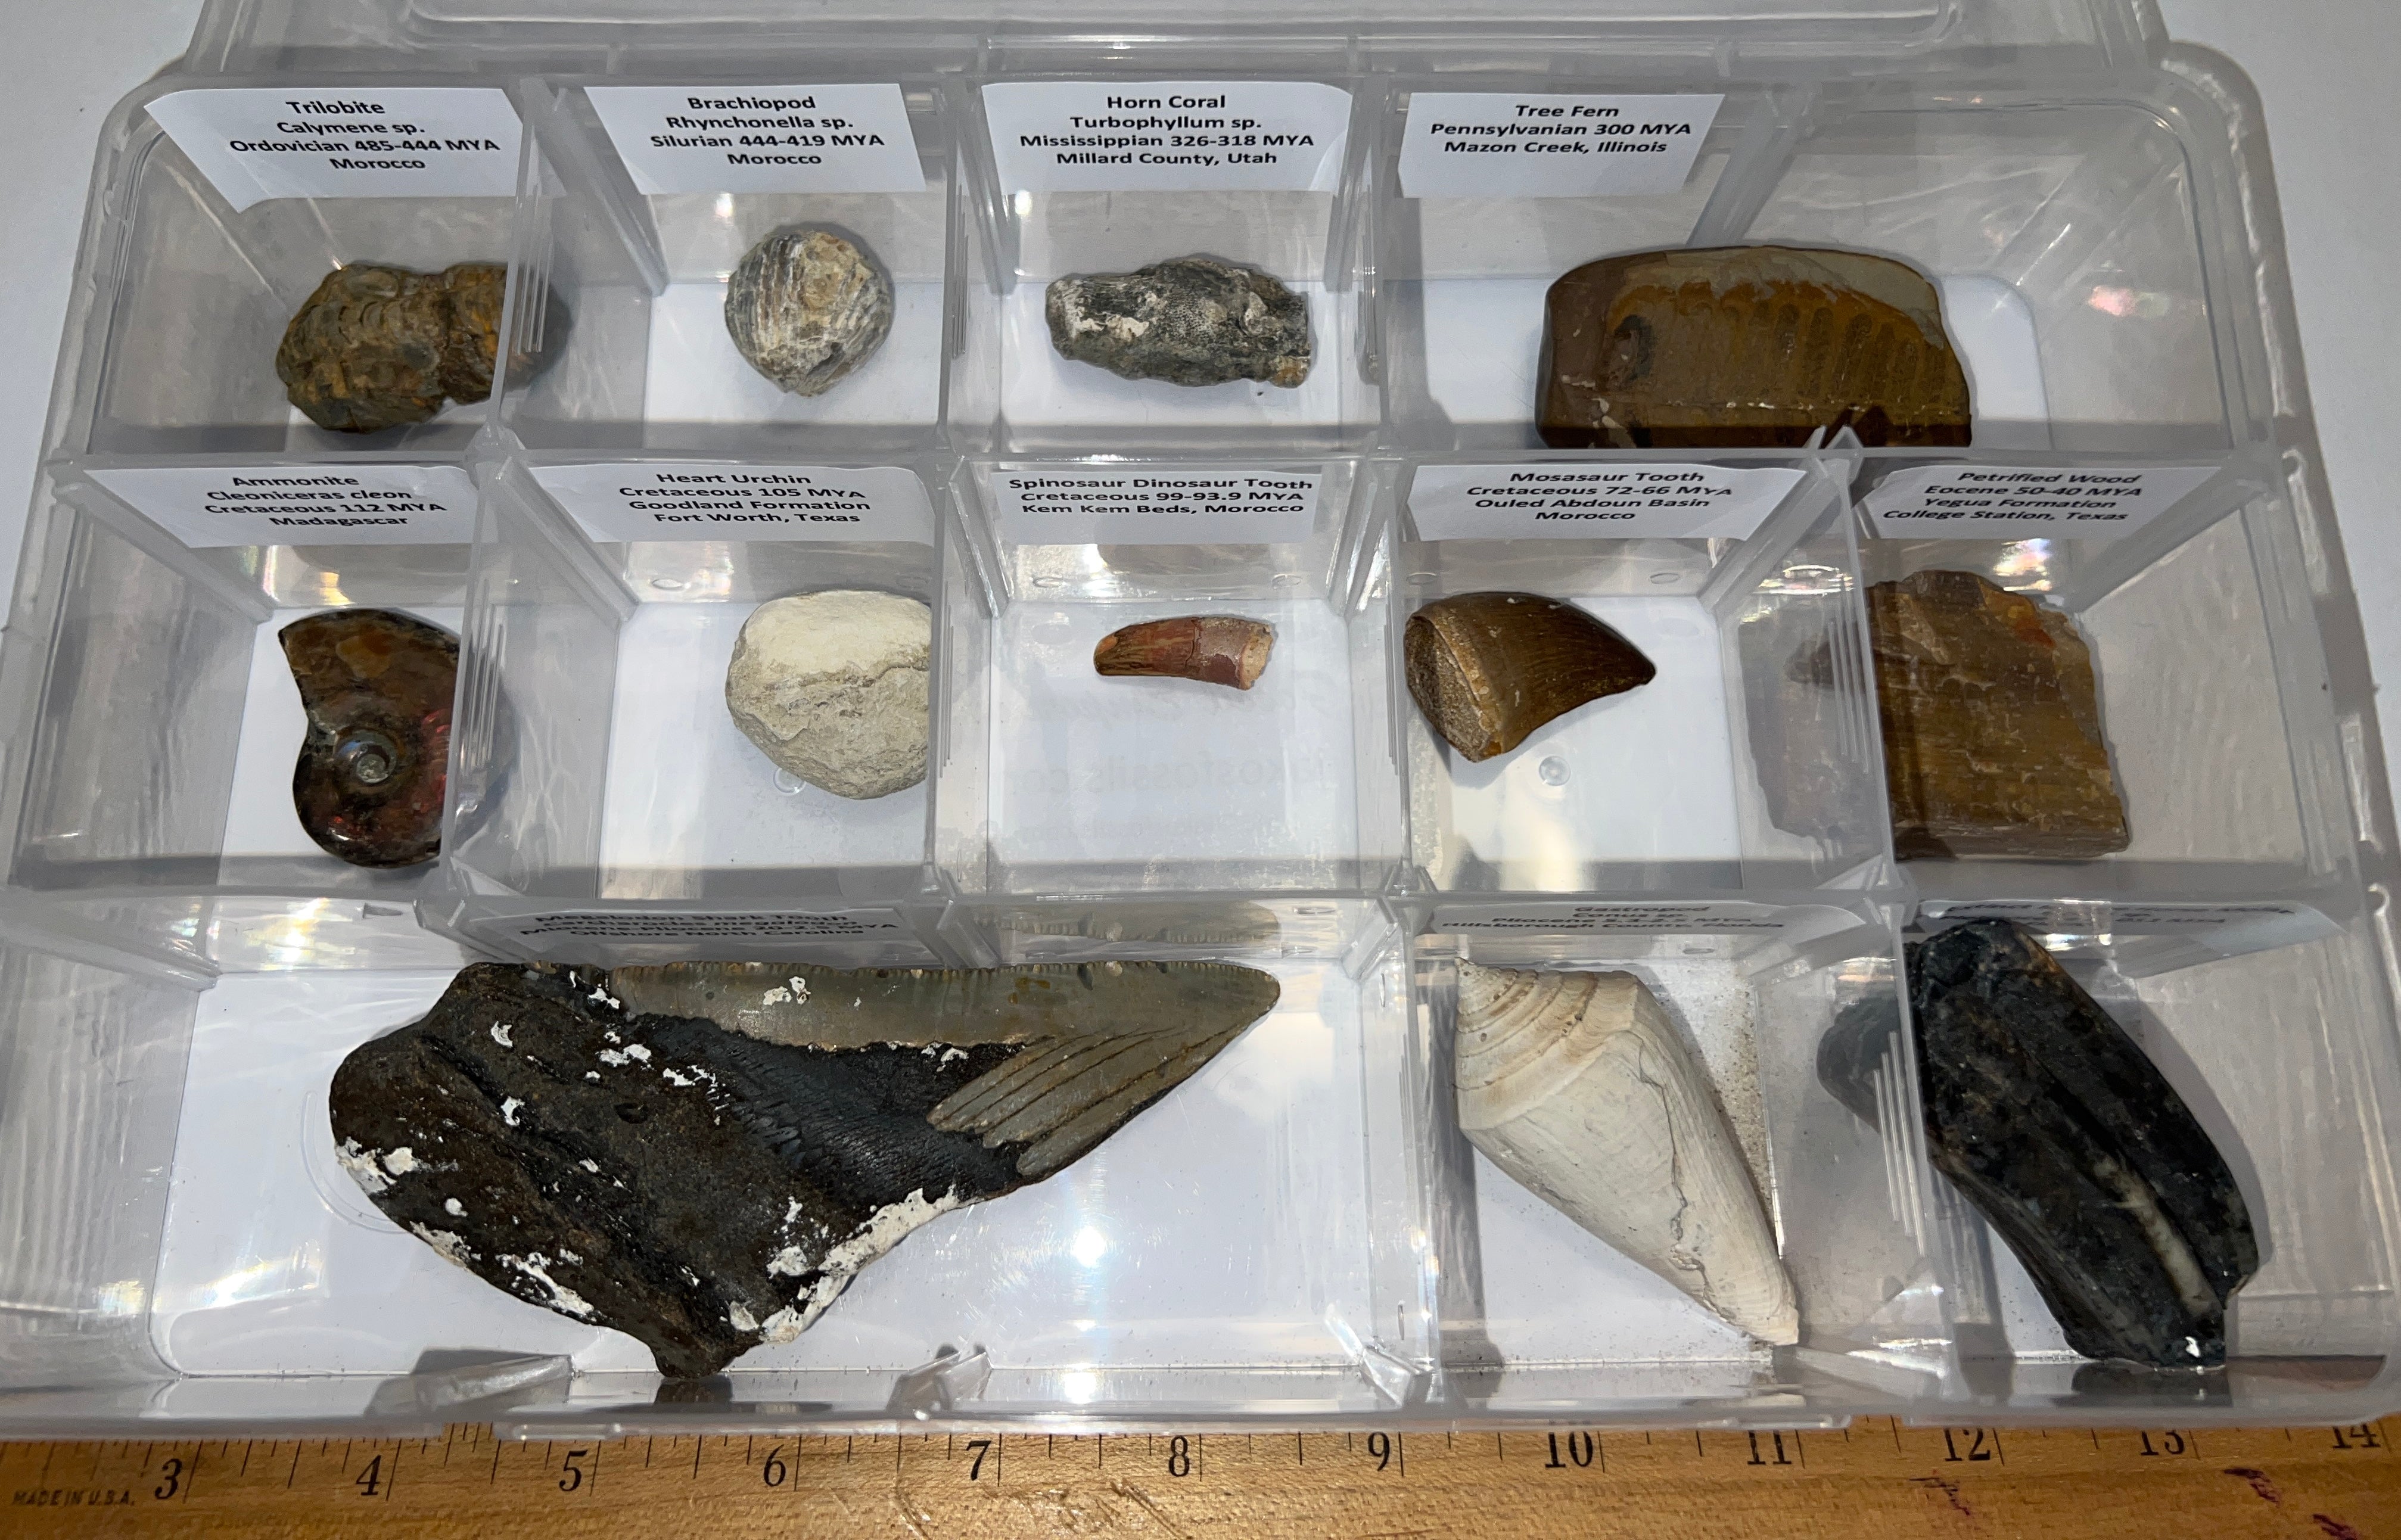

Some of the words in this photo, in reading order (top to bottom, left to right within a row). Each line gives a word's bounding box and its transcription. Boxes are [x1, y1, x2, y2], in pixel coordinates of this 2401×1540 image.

[285, 100, 385, 114] Trilobite
[687, 95, 816, 112] Brachiopod
[1107, 97, 1161, 109] Horn
[1168, 95, 1226, 108] Coral
[1515, 105, 1565, 117] Tree
[1570, 105, 1619, 117] Fern
[276, 122, 388, 136] Calymene
[391, 124, 425, 136] sp.
[665, 116, 815, 131] Rhynchonella
[820, 119, 854, 130] sp.
[1069, 116, 1224, 131] Turbophyllum
[1231, 119, 1261, 130] sp.
[1430, 123, 1587, 138] Pennsylvanian
[1594, 124, 1635, 135] 300
[1639, 123, 1691, 135] MYA
[229, 139, 350, 152] Ordovician
[354, 140, 442, 151] 485-444
[444, 139, 501, 151] MYA
[651, 135, 733, 147] Silurian
[739, 135, 825, 147] 444-419
[831, 135, 885, 146] MYA
[1020, 134, 1163, 149] Mississippian
[1171, 135, 1257, 147] 326-318
[1263, 135, 1314, 146] MYA
[1444, 141, 1517, 153] Mazon
[1524, 141, 1590, 154] Creek,
[1597, 141, 1667, 153] Illinois
[329, 158, 426, 169] Morocco
[727, 154, 822, 164] Morocco
[1056, 152, 1132, 164] Millard
[1139, 153, 1220, 167] County,
[1227, 152, 1277, 164] Utah
[232, 476, 360, 486] Ammonite
[656, 474, 727, 483] Heart
[730, 474, 811, 484] Urchin
[1509, 473, 1629, 482] Mosasaur
[1635, 472, 1705, 482] Tooth
[1957, 472, 2063, 483] Petrified
[2068, 474, 2142, 484] Wood
[1009, 478, 1127, 490] Spinosaur
[1133, 478, 1238, 488] Dinosaur
[1243, 478, 1313, 489] Tooth
[207, 491, 346, 500] Cleoniceras
[350, 490, 412, 499] cleon
[619, 487, 752, 497] Cretaceous
[758, 488, 801, 497] 105
[807, 489, 866, 498] MYA
[1021, 493, 1150, 501] Cretaceous
[1156, 492, 1242, 501] 99-93.9
[1248, 491, 1304, 500] MYA
[1467, 487, 1598, 495] Cretaceous
[1604, 486, 1671, 495] 72-66
[1675, 486, 1731, 496] MYA
[1924, 485, 2009, 494] Eocene
[2013, 486, 2083, 496] 50-40
[2084, 487, 2142, 496] MYA
[204, 505, 337, 514] Cretaceous
[343, 503, 385, 514] 112
[386, 503, 447, 512] MYA
[629, 500, 744, 509] Goodland
[749, 500, 870, 510] Formation
[1475, 499, 1546, 508] Ouled
[1549, 499, 1642, 508] Abdoun
[1647, 498, 1710, 507] Basin
[1925, 498, 1992, 508] Yegua
[1998, 499, 2117, 508] Formation
[1022, 505, 1072, 513] Kem
[1080, 505, 1130, 514] Kem
[1137, 505, 1197, 515] Beds,
[1205, 505, 1304, 513] Morocco
[1535, 512, 1635, 520] Morocco
[1883, 510, 1965, 520] College
[1969, 511, 2055, 521] Station,
[2066, 512, 2129, 520] Texas
[269, 517, 408, 527] Madagascar
[654, 514, 704, 522] Fort
[706, 513, 790, 523] Worth,
[793, 514, 860, 522] Texas
[2332, 1424, 2381, 1449] 14
[1747, 1429, 1792, 1465] 11
[1944, 1428, 1991, 1461] 12
[2139, 1430, 2185, 1456] 13
[1168, 1436, 1190, 1477] 8
[1367, 1432, 1391, 1471] 9
[1545, 1433, 1593, 1468] 10
[763, 1445, 786, 1487] 6
[965, 1441, 991, 1480] 7
[354, 1454, 382, 1497] 4
[559, 1450, 589, 1492] 5
[154, 1458, 184, 1500] 3
